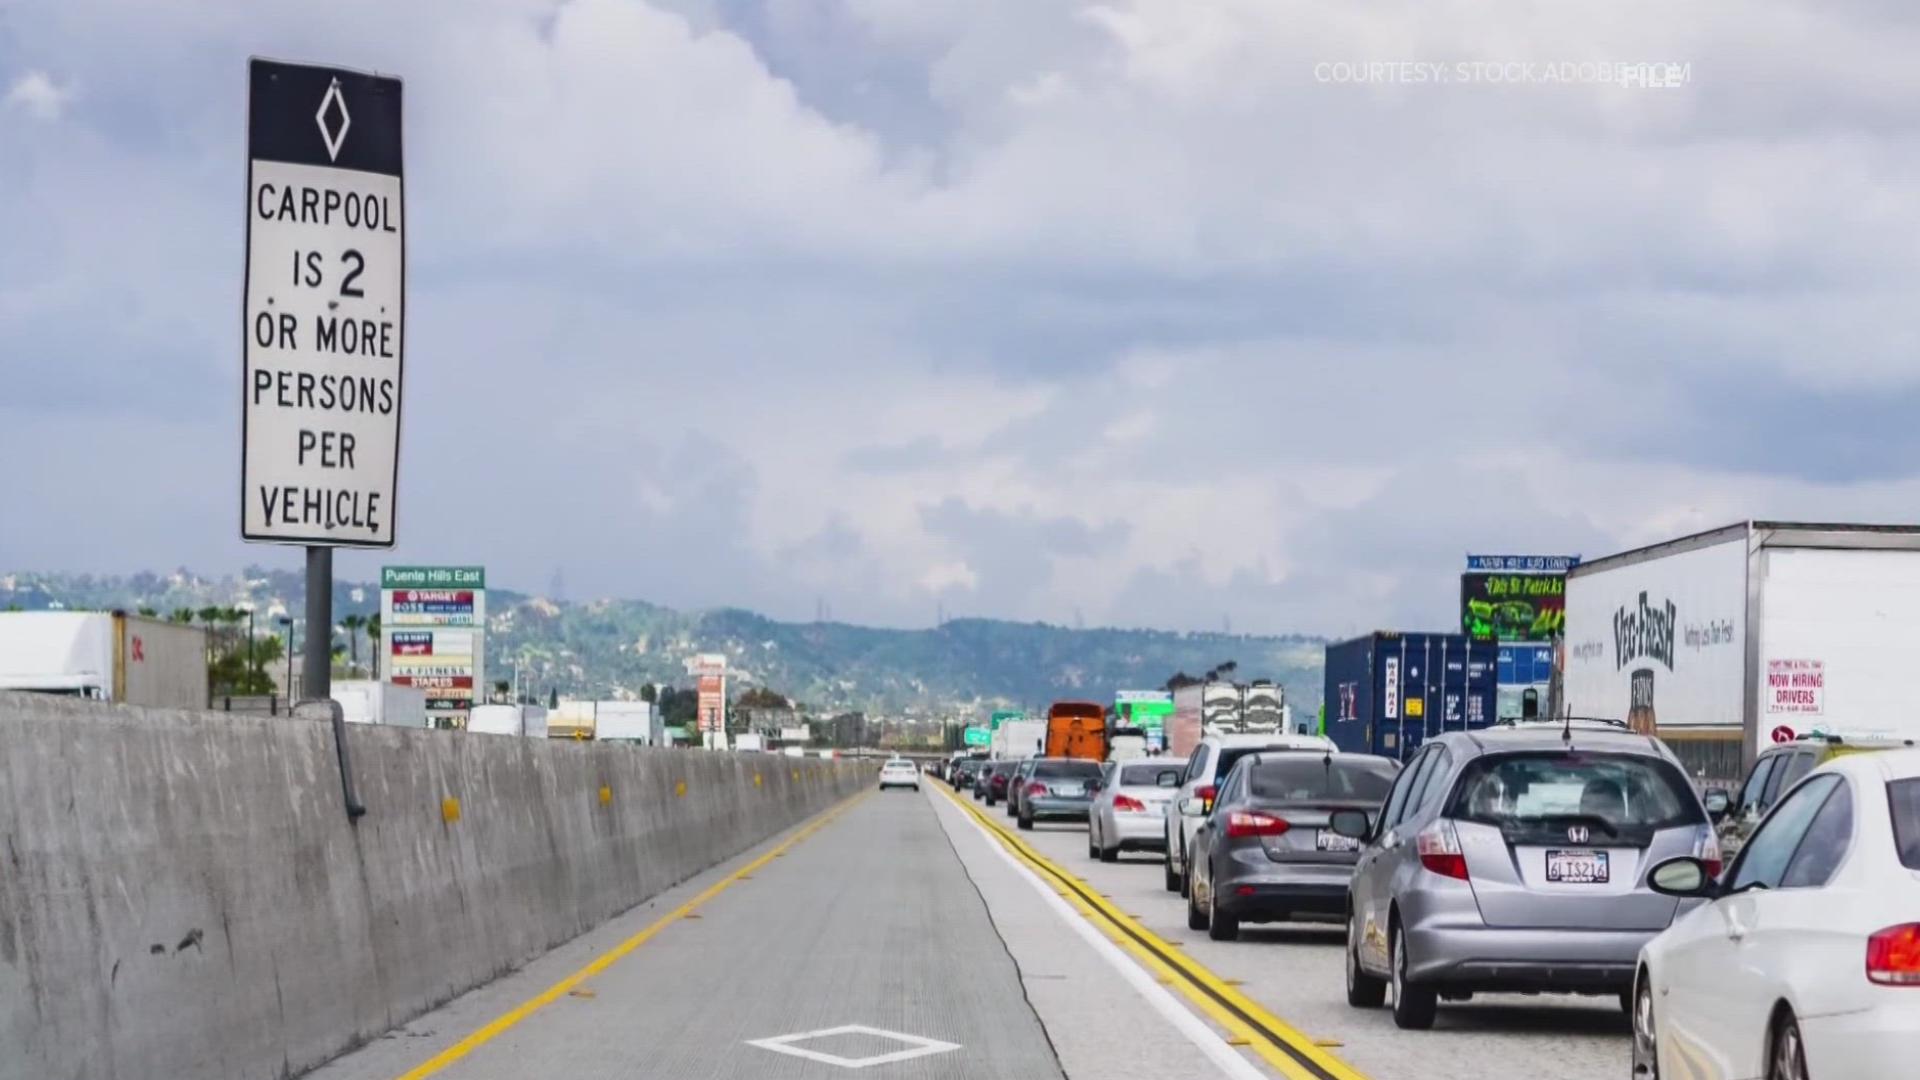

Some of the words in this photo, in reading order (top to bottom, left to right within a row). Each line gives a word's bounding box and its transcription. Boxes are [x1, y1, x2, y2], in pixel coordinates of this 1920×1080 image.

[258, 183, 397, 233] CARPOOL
[293, 249, 323, 288] IS
[340, 248, 366, 298] 2
[255, 311, 298, 350] OR
[316, 315, 394, 358] MORE
[254, 368, 394, 415] PERSONS
[298, 429, 356, 469] PER
[260, 485, 381, 529] VEHICLE
[385, 569, 426, 581] Puente
[428, 570, 452, 581] Hills
[455, 569, 480, 581] East
[419, 591, 458, 601] TARGET
[411, 677, 454, 689] STAPLES
[1769, 673, 1790, 688] NOW
[1792, 673, 1823, 688] HIRING
[1776, 689, 1815, 704] DRIVERS
